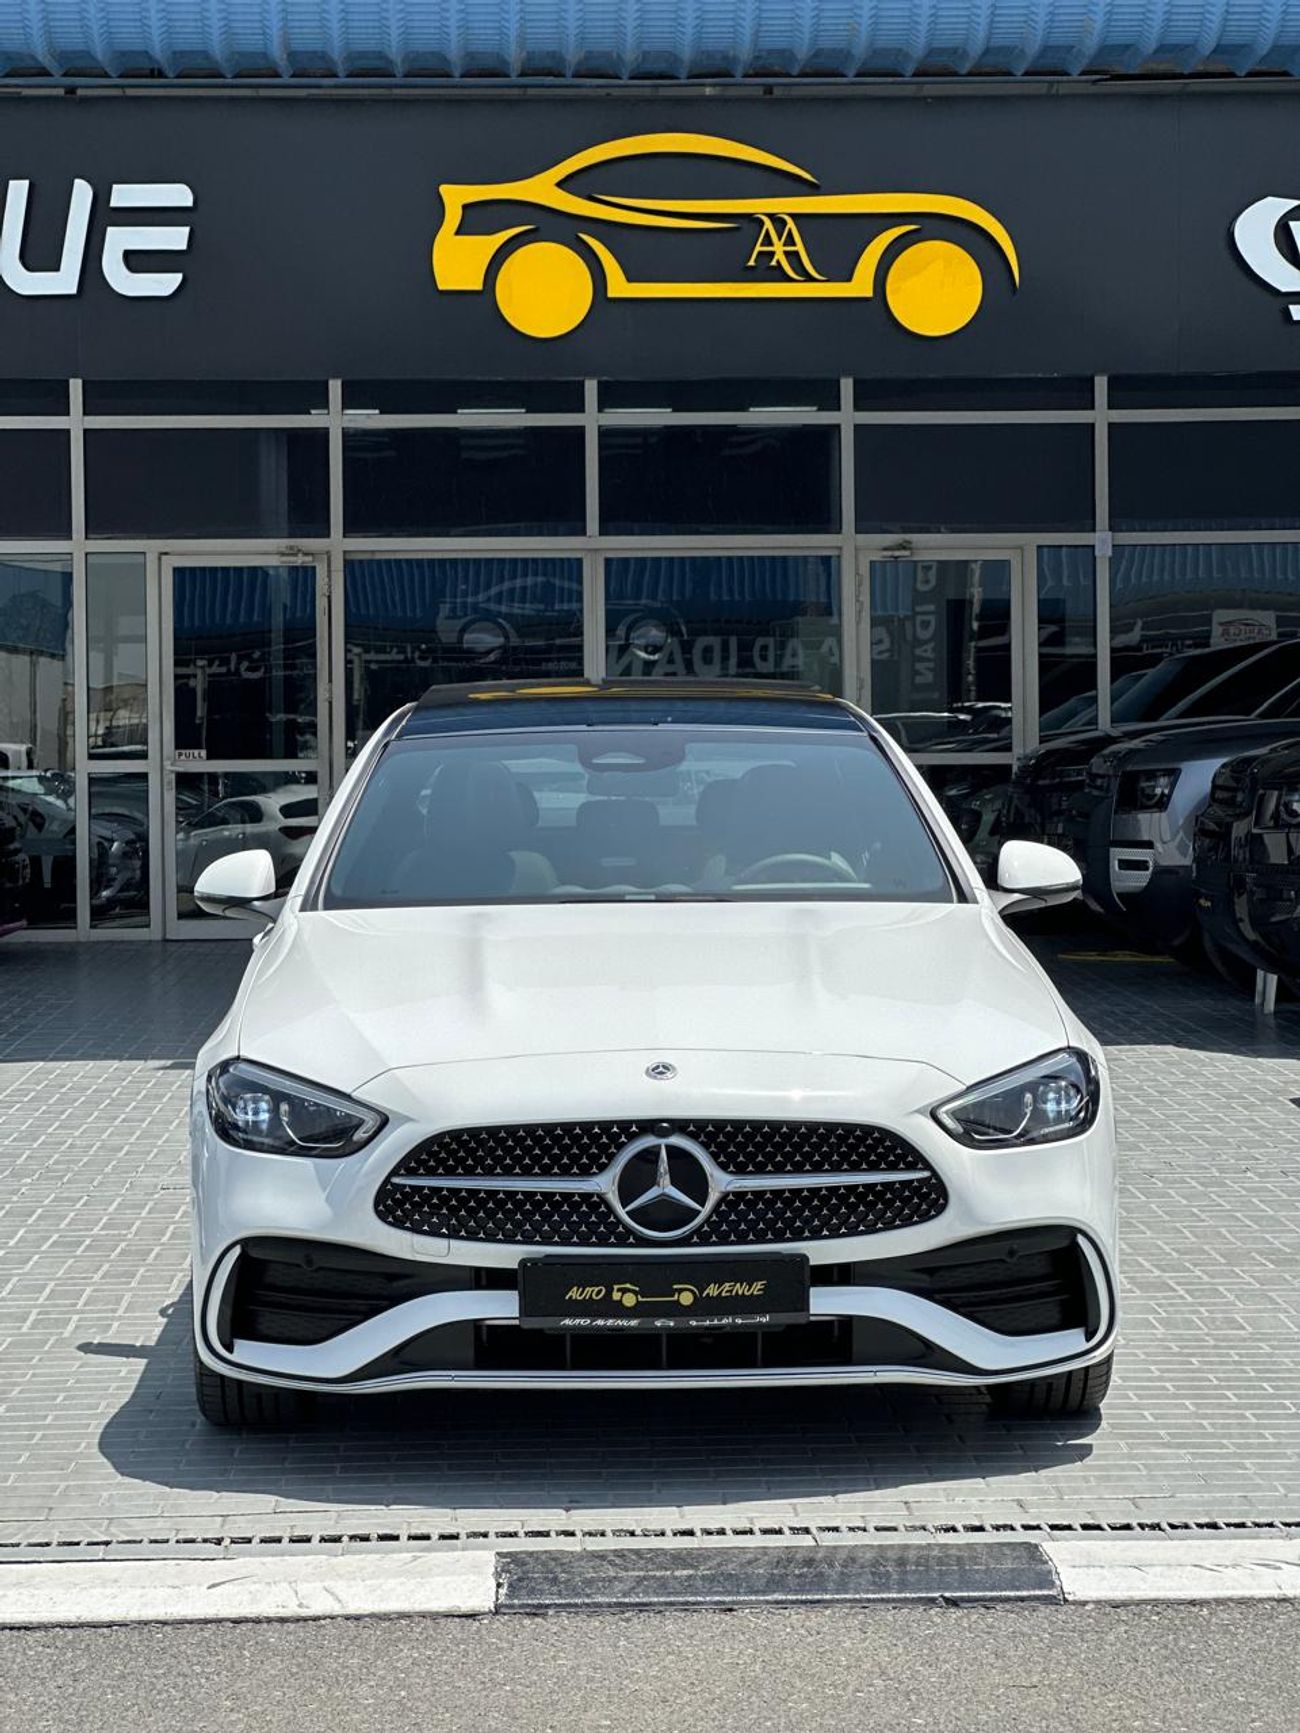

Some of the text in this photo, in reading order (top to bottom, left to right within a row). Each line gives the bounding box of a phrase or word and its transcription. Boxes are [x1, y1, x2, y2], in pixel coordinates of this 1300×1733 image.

[177, 751, 204, 760] PULL
[565, 1281, 767, 1300] AUTO AVENUE
[560, 1318, 640, 1327] AUTO AVENUE
